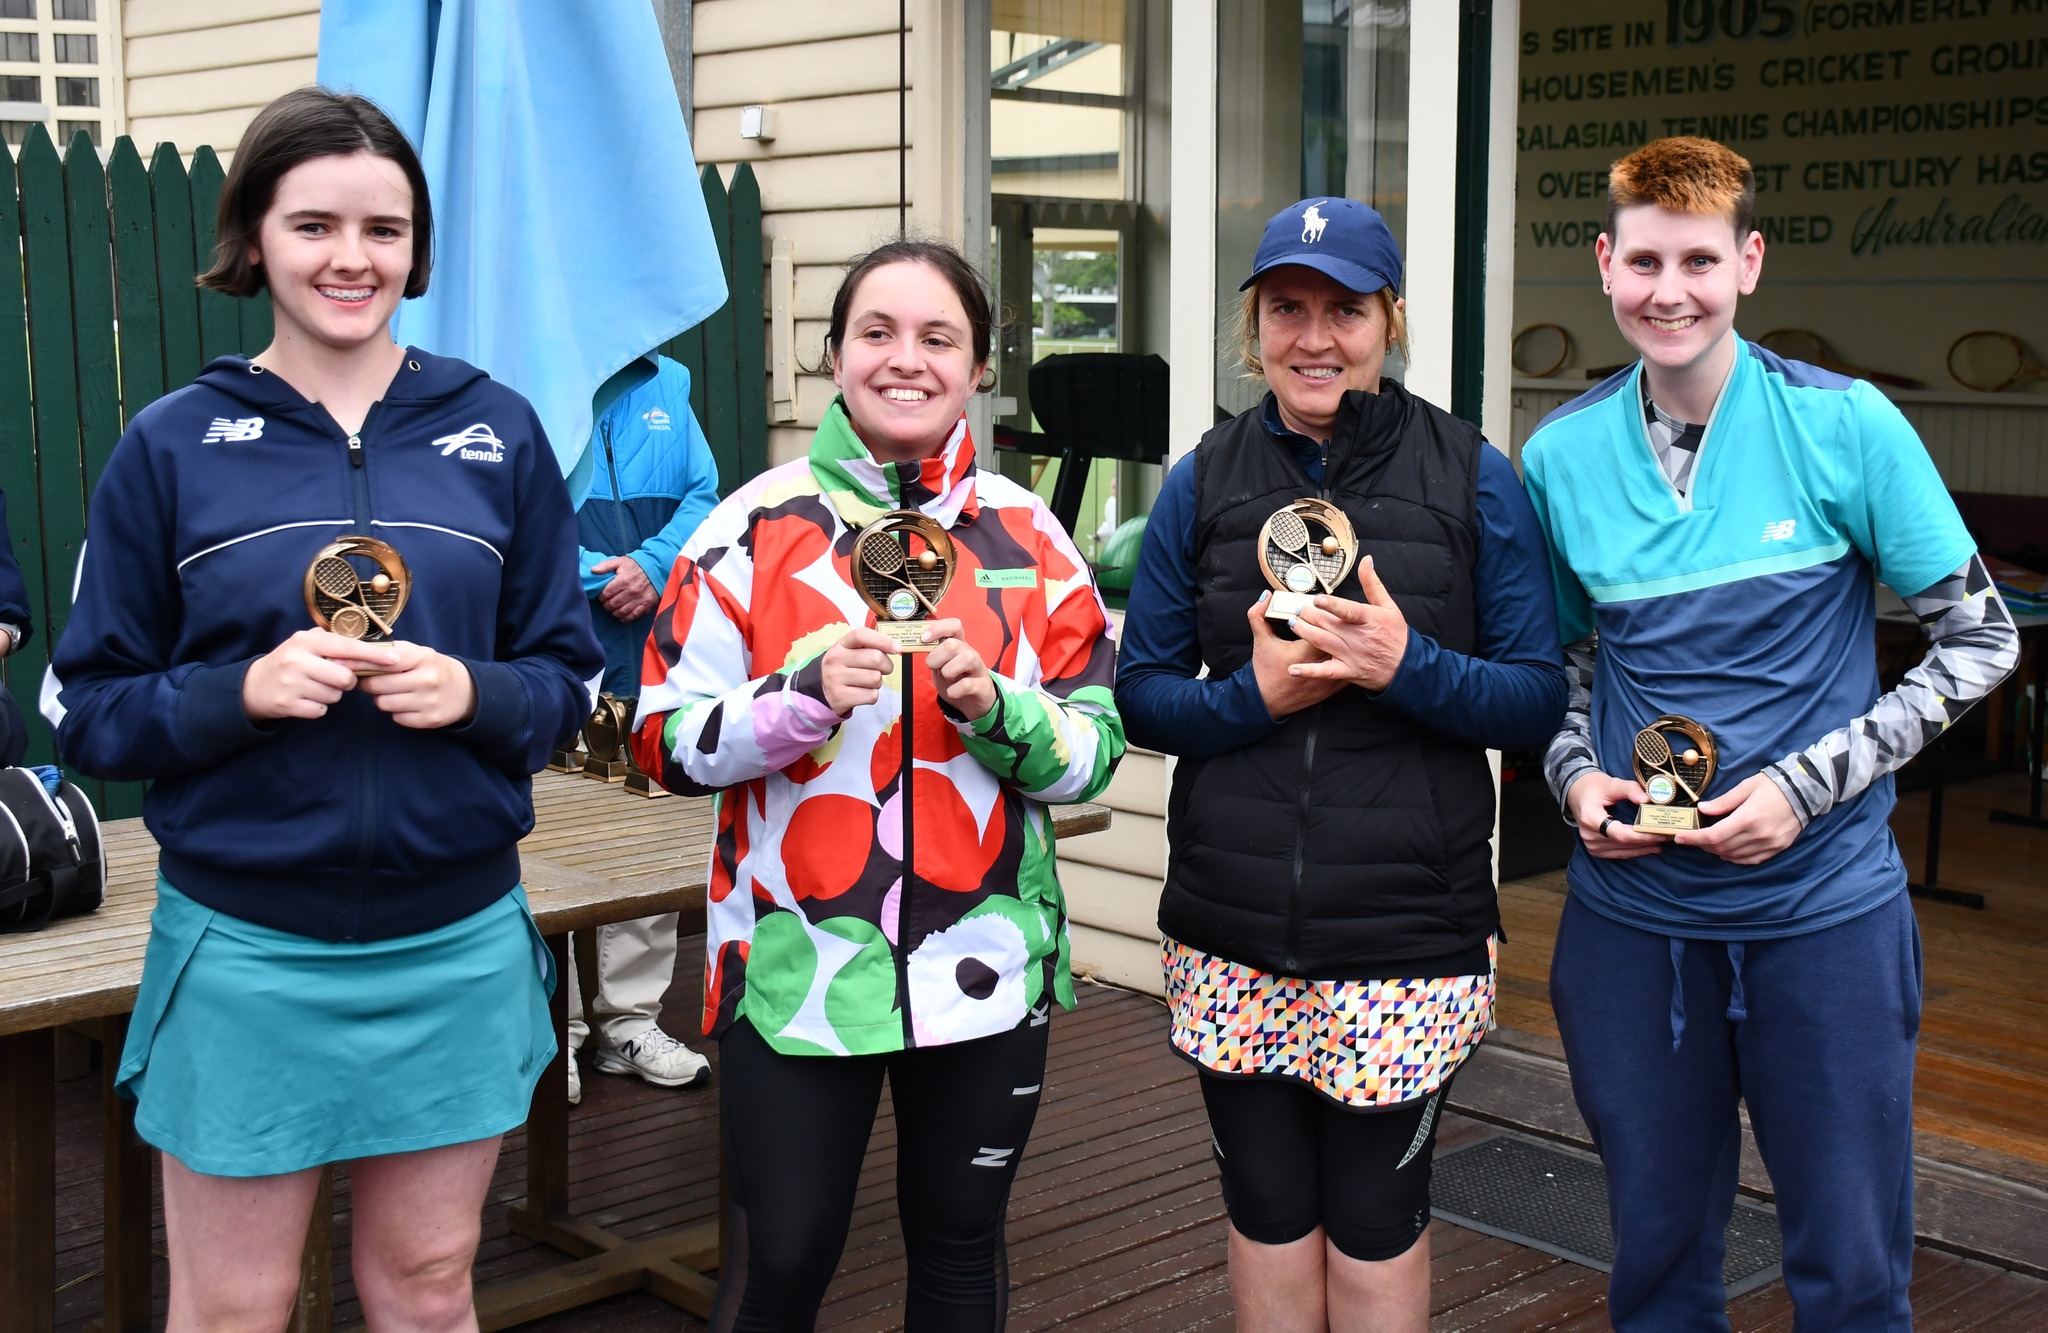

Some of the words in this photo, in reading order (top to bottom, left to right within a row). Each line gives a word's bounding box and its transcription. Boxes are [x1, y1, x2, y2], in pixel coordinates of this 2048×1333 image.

[1552, 24, 1613, 53] SITE
[1624, 21, 1654, 48] IN
[1666, 0, 1797, 45] 1905
[1803, 0, 1991, 38] (FORMERLY
[1760, 50, 1910, 87] CRICKET
[1661, 114, 1769, 141] TENNIS
[1782, 97, 2048, 138] CHAMPIONSHIPS
[1803, 156, 1963, 192] CENTURY
[1977, 152, 2048, 185] HAS
[1531, 221, 1604, 248] WOR
[460, 447, 504, 463] tennis
